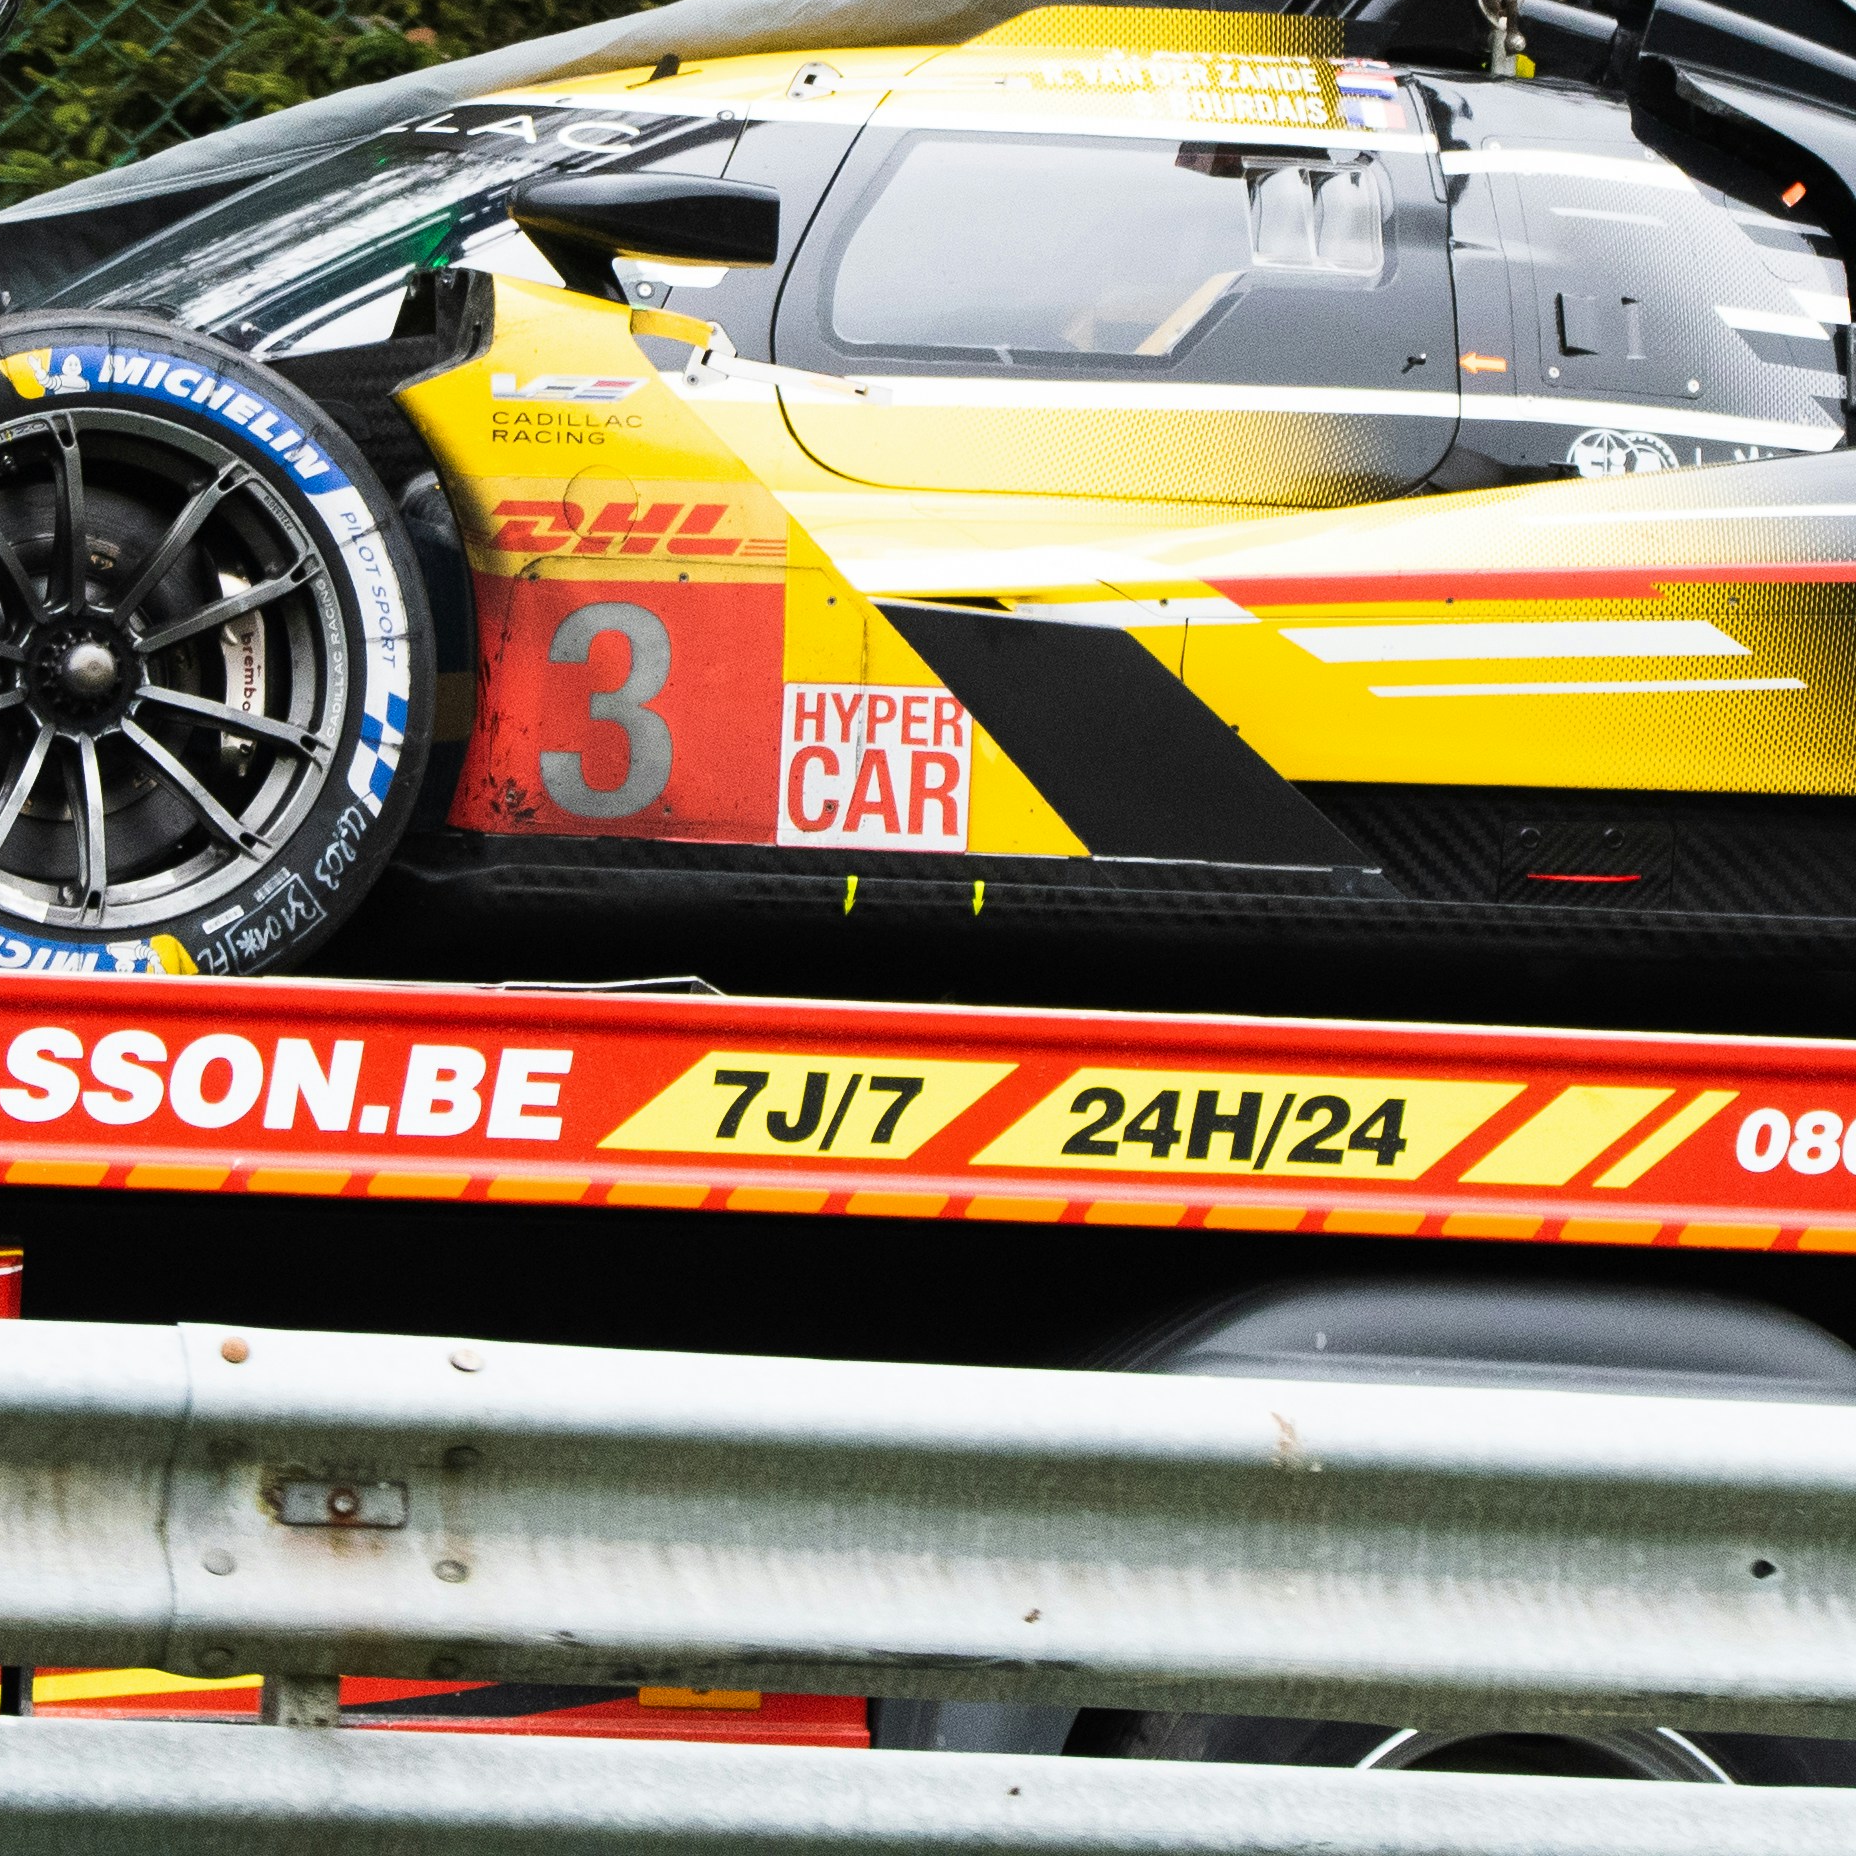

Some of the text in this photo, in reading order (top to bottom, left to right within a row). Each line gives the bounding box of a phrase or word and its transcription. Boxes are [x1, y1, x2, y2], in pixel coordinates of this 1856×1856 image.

[1154, 63, 1210, 87] DER
[1218, 64, 1322, 93] ZANDE
[1171, 95, 1329, 124] BOURDAIS
[97, 354, 330, 480] MICHELIN
[492, 411, 643, 428] CADILLAC
[492, 429, 606, 445] RACING
[492, 499, 744, 557] DHL
[340, 510, 396, 669] PILOT SPORT
[241, 631, 257, 712] brembo
[326, 650, 345, 738] CADILLAC
[539, 601, 673, 819] 3
[793, 691, 965, 748] HYPER
[787, 745, 961, 837] CAR
[711, 1068, 1408, 1171] 7J/7 24H/24
